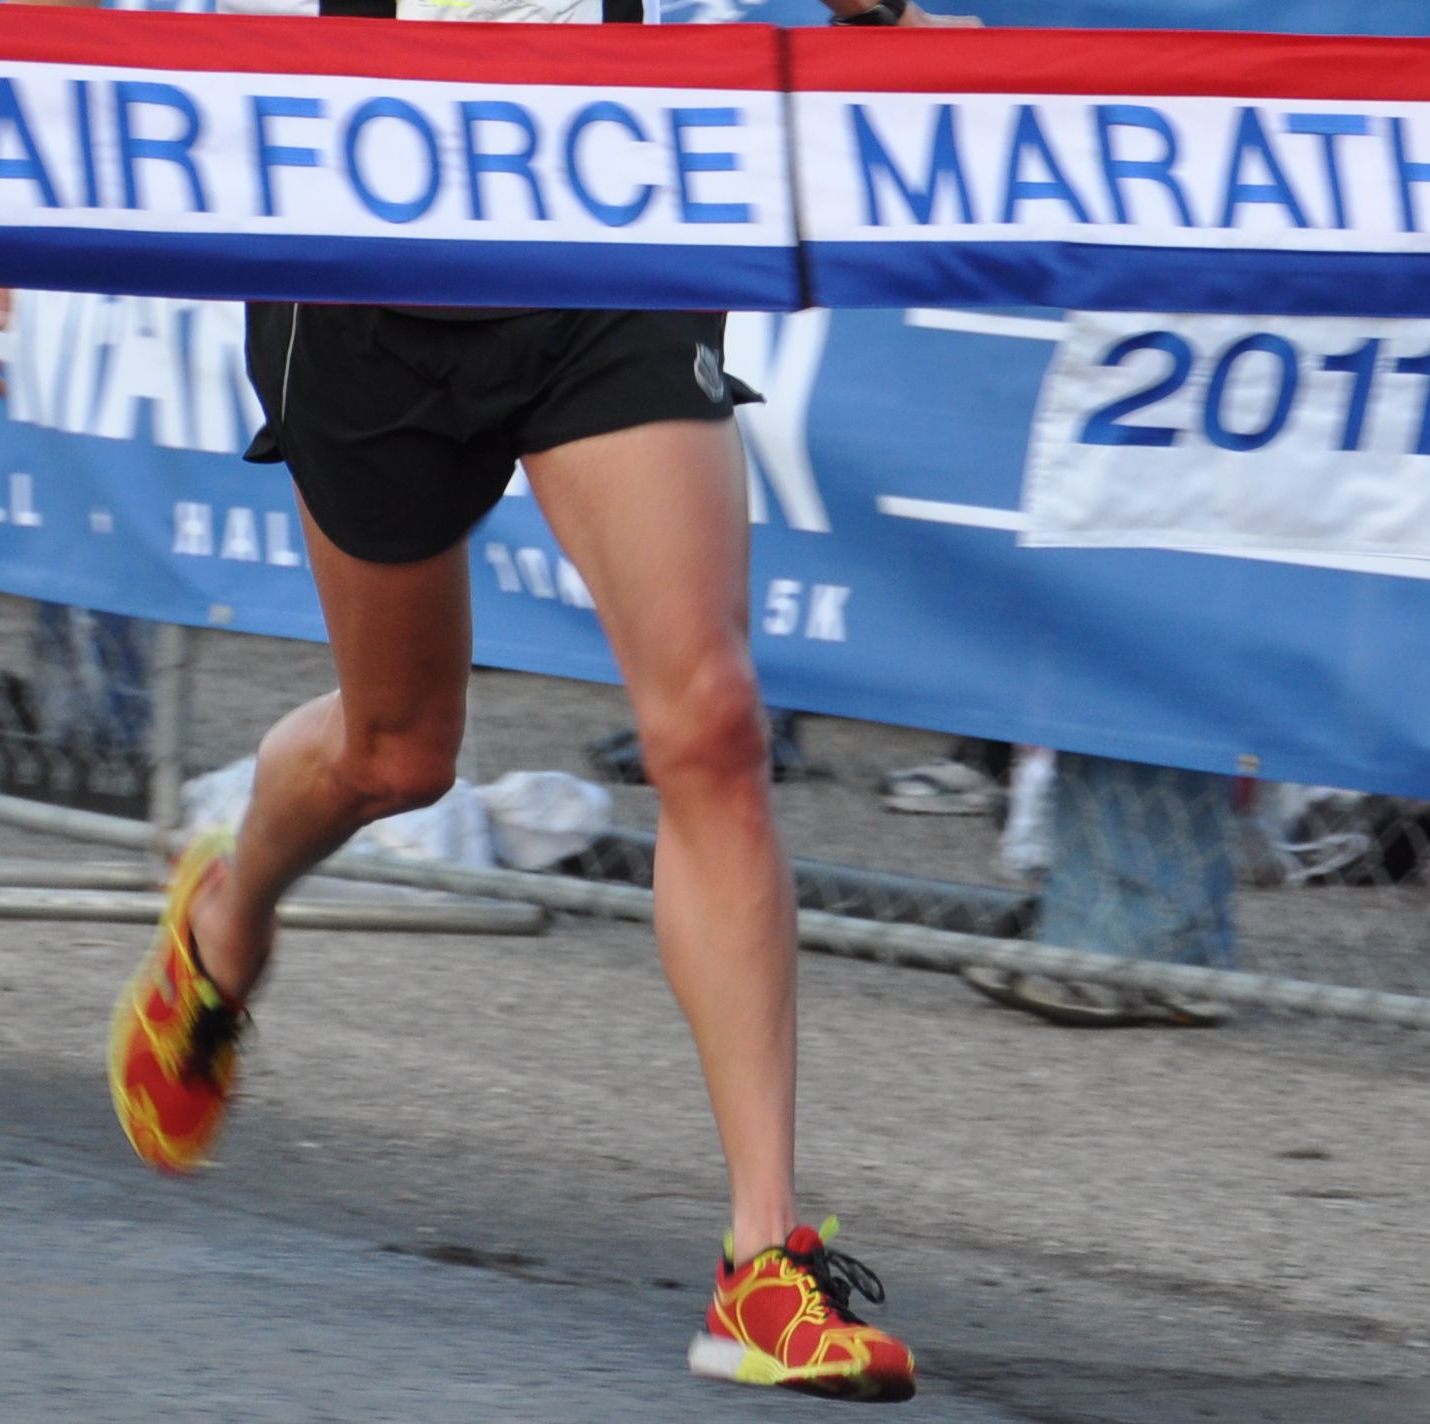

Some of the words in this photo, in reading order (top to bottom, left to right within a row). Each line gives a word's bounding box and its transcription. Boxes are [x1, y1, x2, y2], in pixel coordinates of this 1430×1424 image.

[247, 96, 756, 228] FORCE
[173, 501, 311, 568] HAL
[763, 579, 852, 642] 5K
